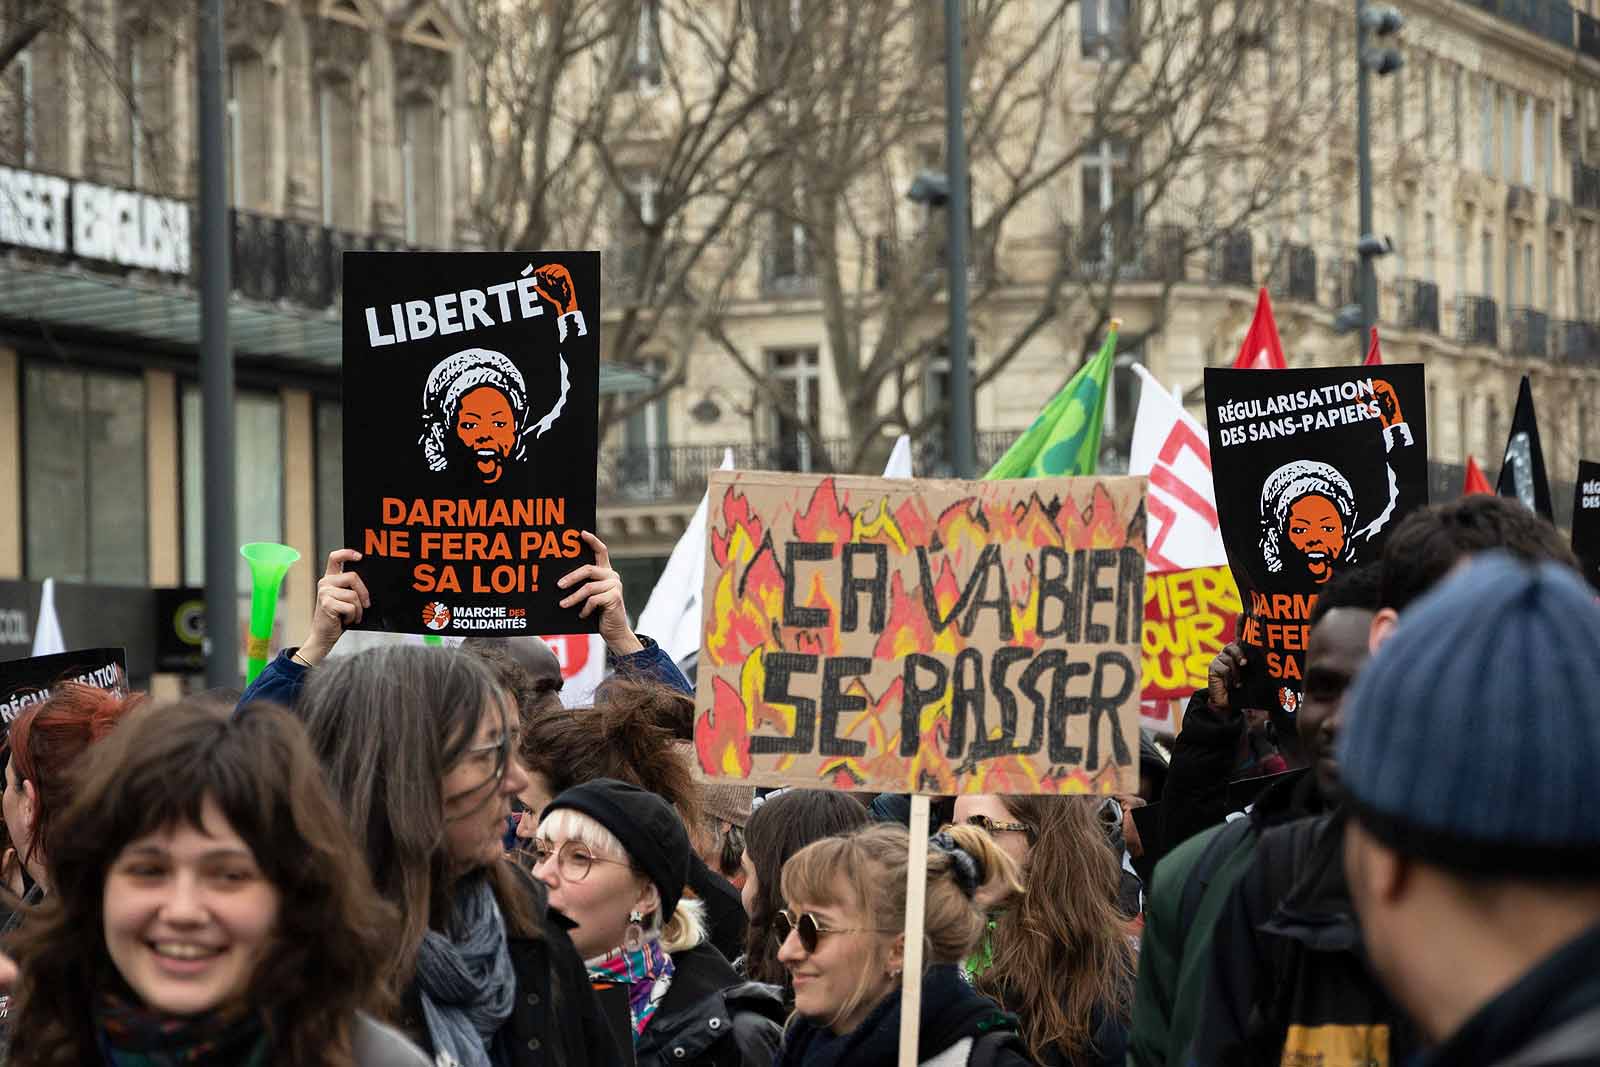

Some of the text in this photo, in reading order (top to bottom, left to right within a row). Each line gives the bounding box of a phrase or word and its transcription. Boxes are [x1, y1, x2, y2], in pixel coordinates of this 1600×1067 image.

[365, 263, 544, 347] LIBERTÉ
[1217, 378, 1375, 423] RÉGULARISATION
[1220, 400, 1381, 447] DES SANS-PAPIERS
[382, 497, 565, 527] DARMANIN
[365, 528, 581, 560] NE FERA PAS
[412, 565, 462, 593] SA
[915, 543, 1013, 641] VA
[1036, 545, 1146, 644] BIEN
[453, 606, 526, 618] MARCHE DES
[1250, 591, 1319, 620] DARM
[453, 616, 527, 630] SOLIDARITÉS
[1141, 614, 1225, 657] OUR
[1267, 652, 1303, 680] SA
[749, 647, 1135, 771] SE PASSER
